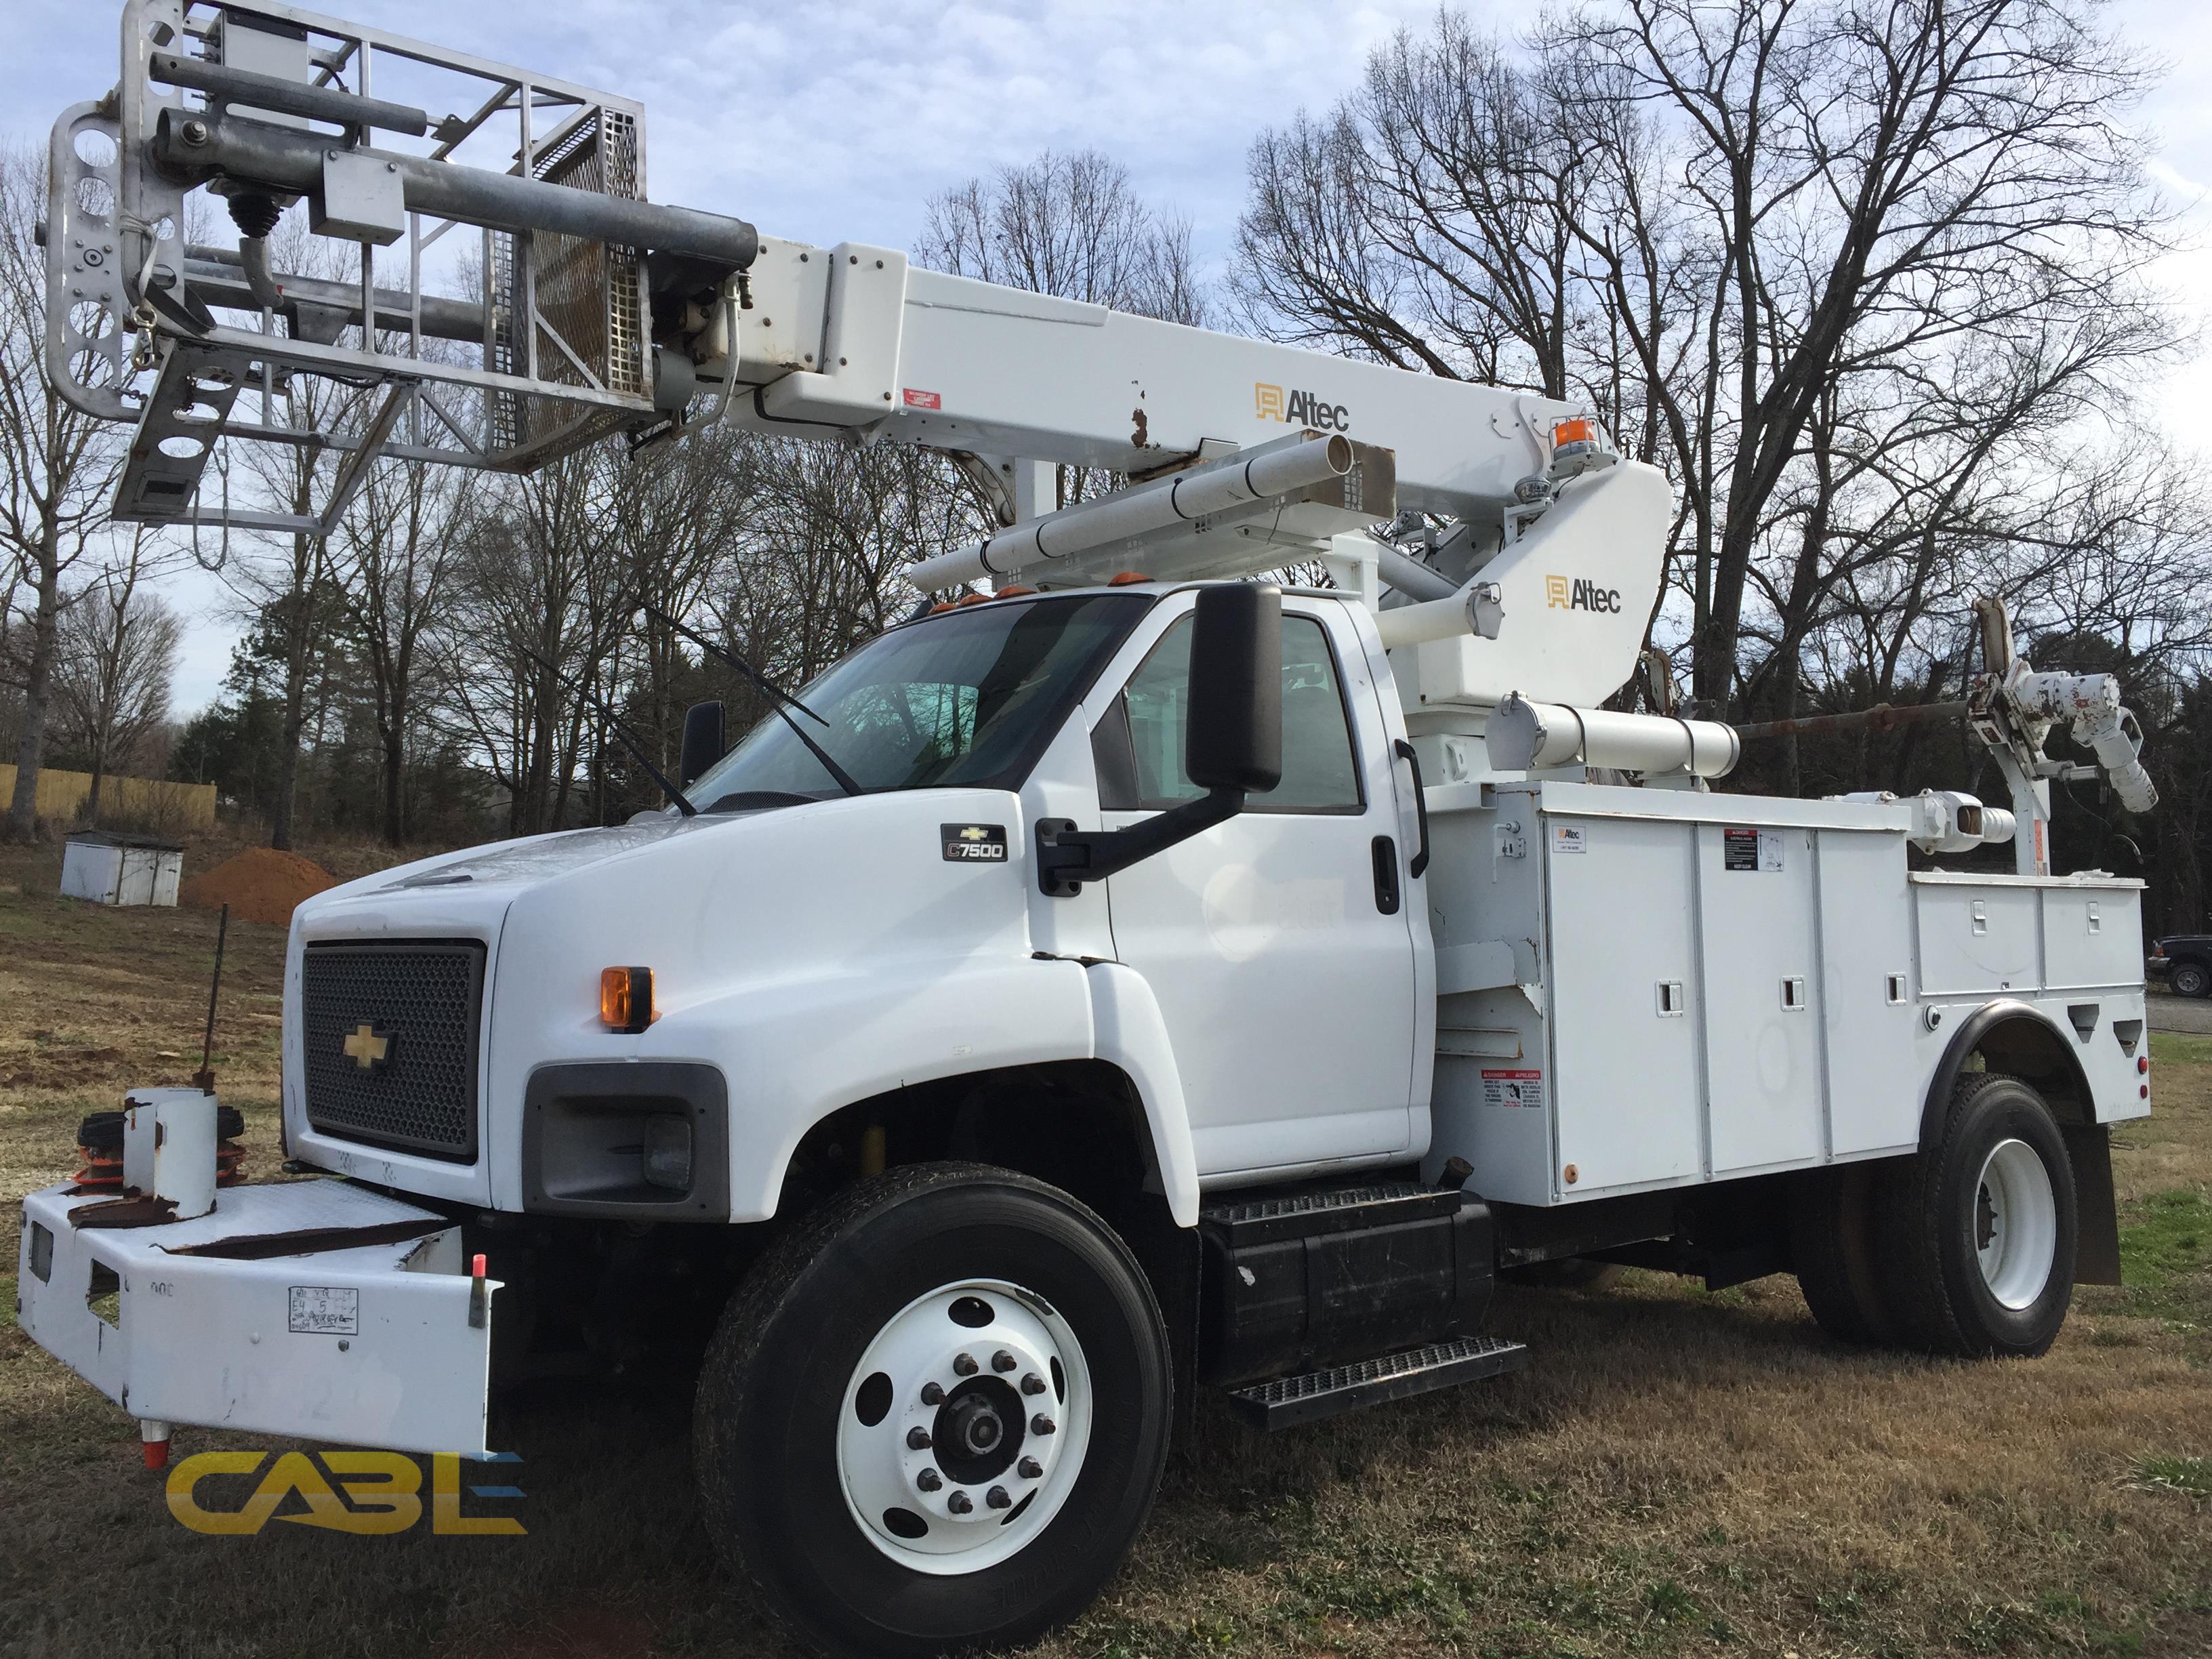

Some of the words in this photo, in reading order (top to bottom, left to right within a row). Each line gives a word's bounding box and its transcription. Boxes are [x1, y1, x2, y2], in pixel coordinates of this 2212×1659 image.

[1286, 390, 1350, 432] Altec
[1571, 578, 1621, 614] Altec
[947, 843, 1004, 858] C7500
